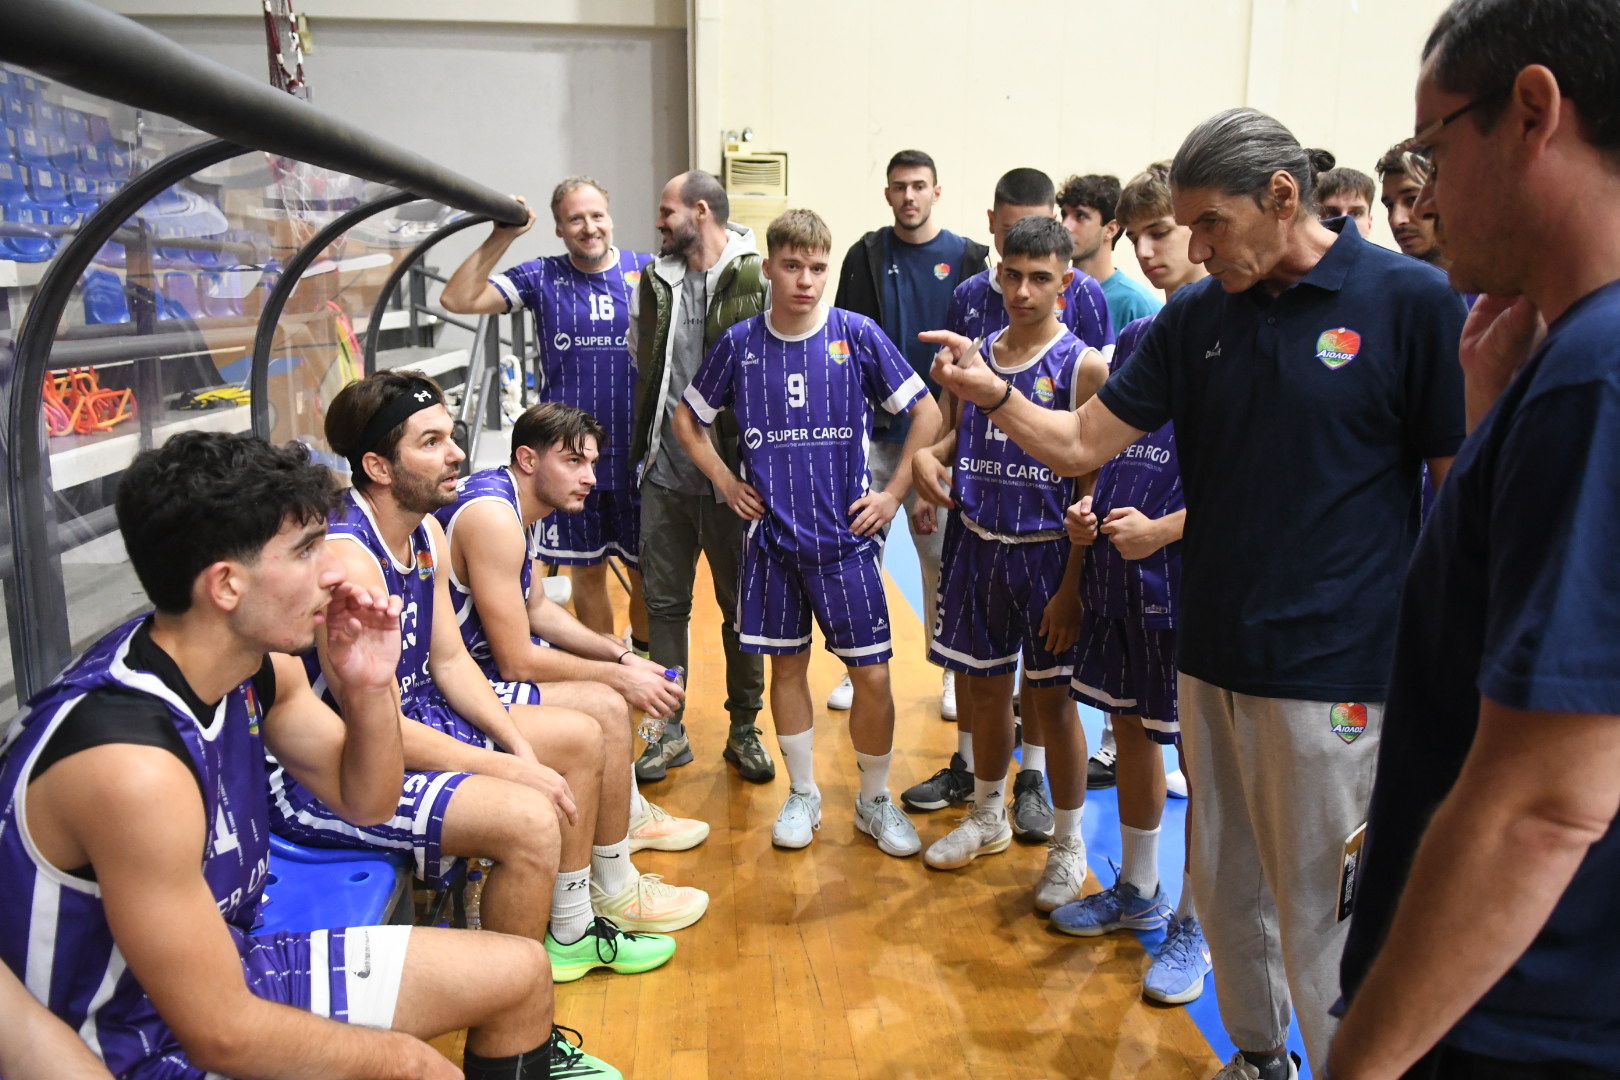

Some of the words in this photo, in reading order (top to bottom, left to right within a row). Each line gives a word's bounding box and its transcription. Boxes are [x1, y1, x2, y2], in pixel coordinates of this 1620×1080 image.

[589, 293, 615, 320] 16
[574, 336, 612, 346] SUPER
[787, 373, 806, 408] 9
[767, 429, 809, 442] SUPER
[813, 427, 853, 440] CARGO
[959, 457, 1002, 476] SUPER
[1006, 463, 1062, 484] CARGO
